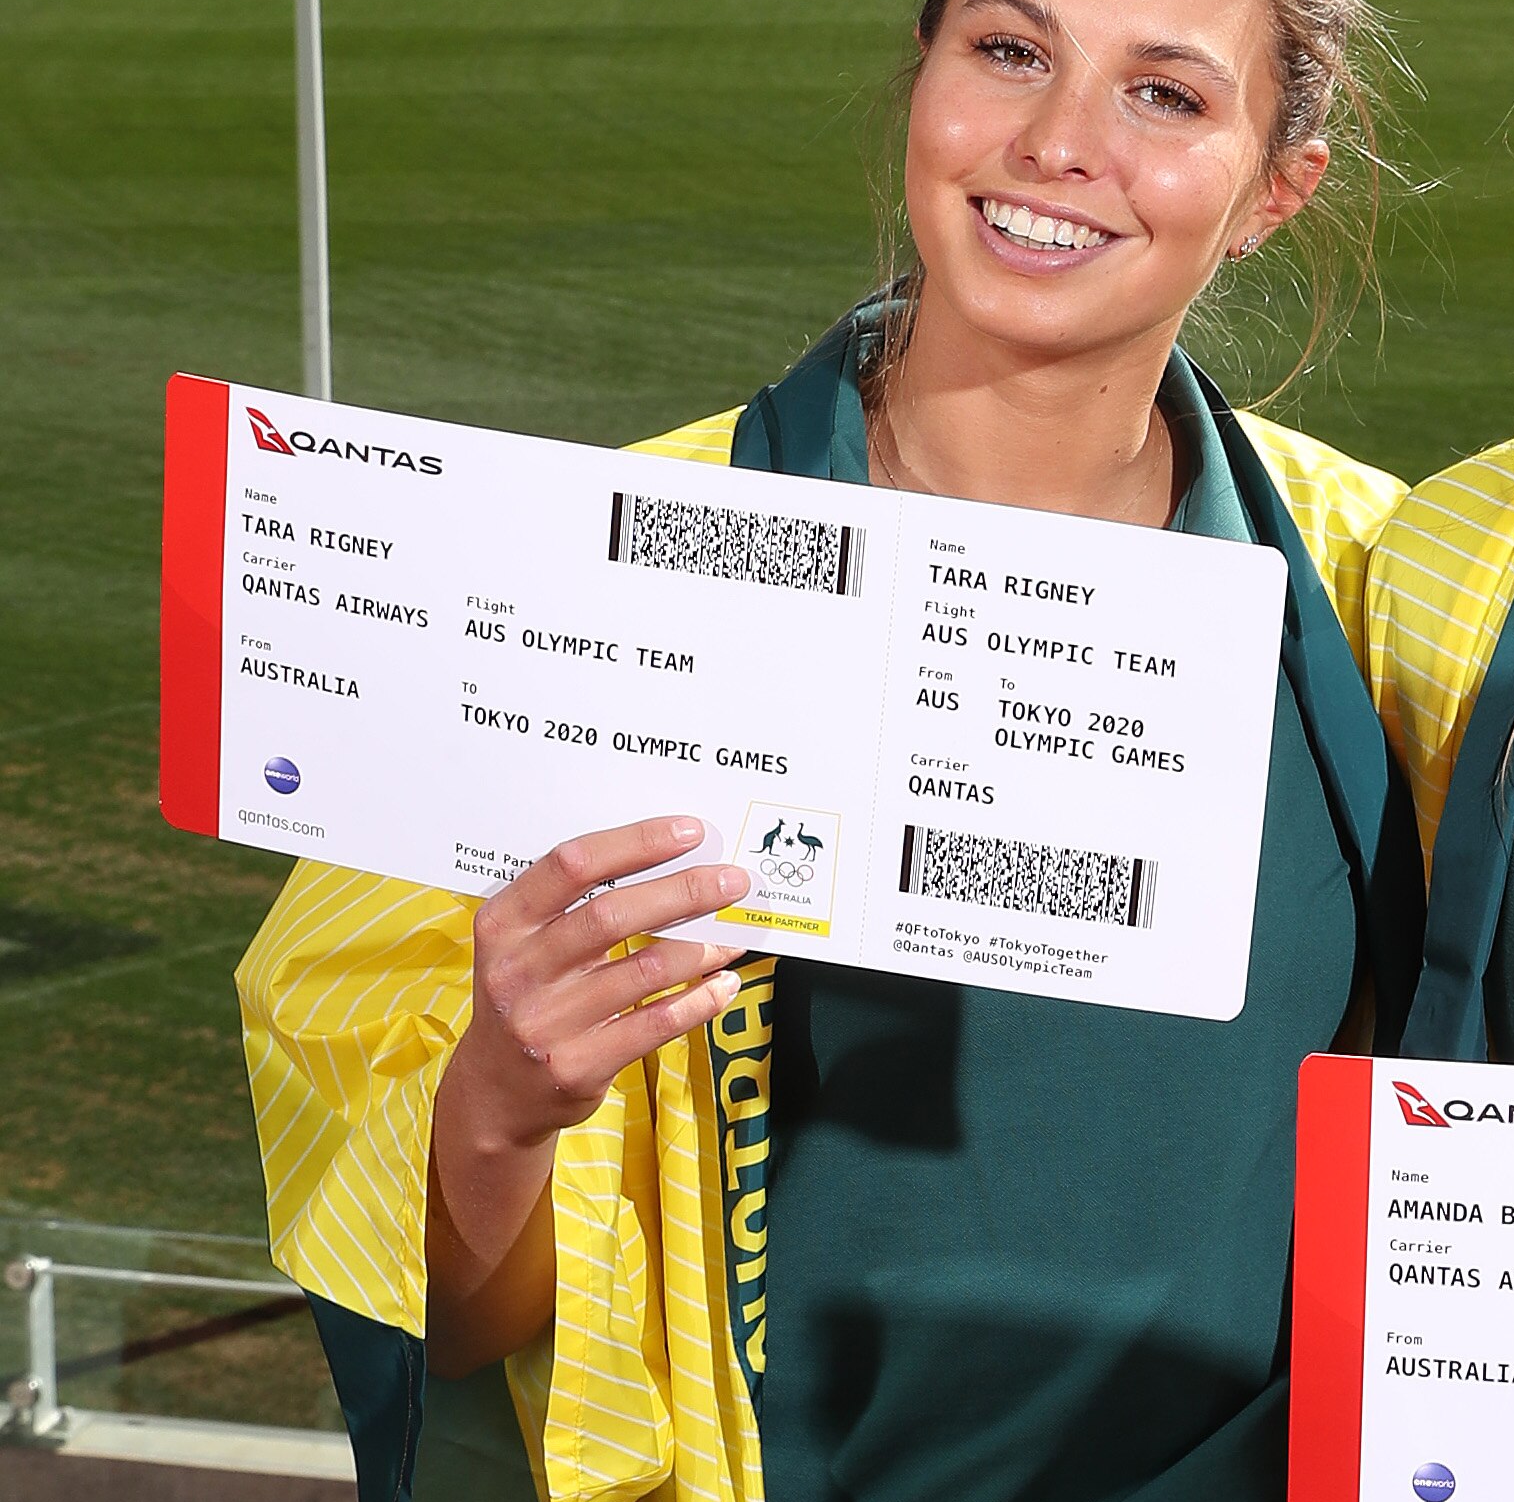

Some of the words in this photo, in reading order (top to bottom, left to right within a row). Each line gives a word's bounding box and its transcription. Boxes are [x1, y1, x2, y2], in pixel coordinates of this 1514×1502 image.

[289, 430, 443, 476] QANTAS
[244, 488, 277, 505] Name
[241, 513, 296, 542] TARA
[310, 527, 394, 560] RIGNEY
[929, 538, 966, 555] Name
[242, 551, 296, 572] Carrier
[928, 564, 988, 591] TARA
[1004, 575, 1096, 606] RIGNEY
[242, 573, 321, 606] QANTAS
[335, 593, 429, 628] AIRWAYS
[466, 596, 515, 615] Flight
[924, 600, 976, 619] Flight
[240, 634, 272, 651] From
[464, 618, 506, 643] AUS
[522, 629, 619, 663] OLYMPIC
[636, 647, 694, 674] TEAM
[921, 622, 968, 647] AUS
[987, 632, 1094, 666] OLYMPIC
[1113, 650, 1176, 678] TEAM
[240, 656, 360, 699] AUSTRALIA
[918, 666, 953, 681] From
[1000, 677, 1016, 691] To
[915, 688, 959, 711] AUS
[998, 699, 1072, 727] TOKYO
[1087, 712, 1144, 738] 2020
[460, 703, 530, 734] TOKYO
[543, 719, 598, 747] 2020
[612, 731, 702, 763] OLYMPIC
[715, 747, 789, 775] GAMES
[994, 727, 1095, 760] OLYMPIC
[1111, 744, 1185, 773] GAMES
[910, 754, 970, 772] Carrier
[908, 774, 994, 805] QANTAS
[238, 809, 325, 839] qantas.com
[456, 843, 495, 861] Proud
[503, 853, 534, 869] Part
[454, 858, 515, 882] Australi
[757, 889, 813, 906] AUSTRALIA
[744, 912, 773, 925] TEAM
[775, 917, 820, 932] PARTNER
[895, 921, 980, 946] #QFtoTokyo
[989, 936, 1109, 964] #TokyoTogether
[893, 939, 954, 959] @Qantas
[962, 950, 1093, 979] @AUSOlympicTeam
[1391, 1169, 1429, 1184] Name
[1387, 1198, 1484, 1224] AMANDA
[1389, 1238, 1452, 1255] Carrier
[1388, 1262, 1481, 1289] QANTAS
[1386, 1331, 1423, 1346] From
[1413, 1478, 1455, 1489] oneworld
